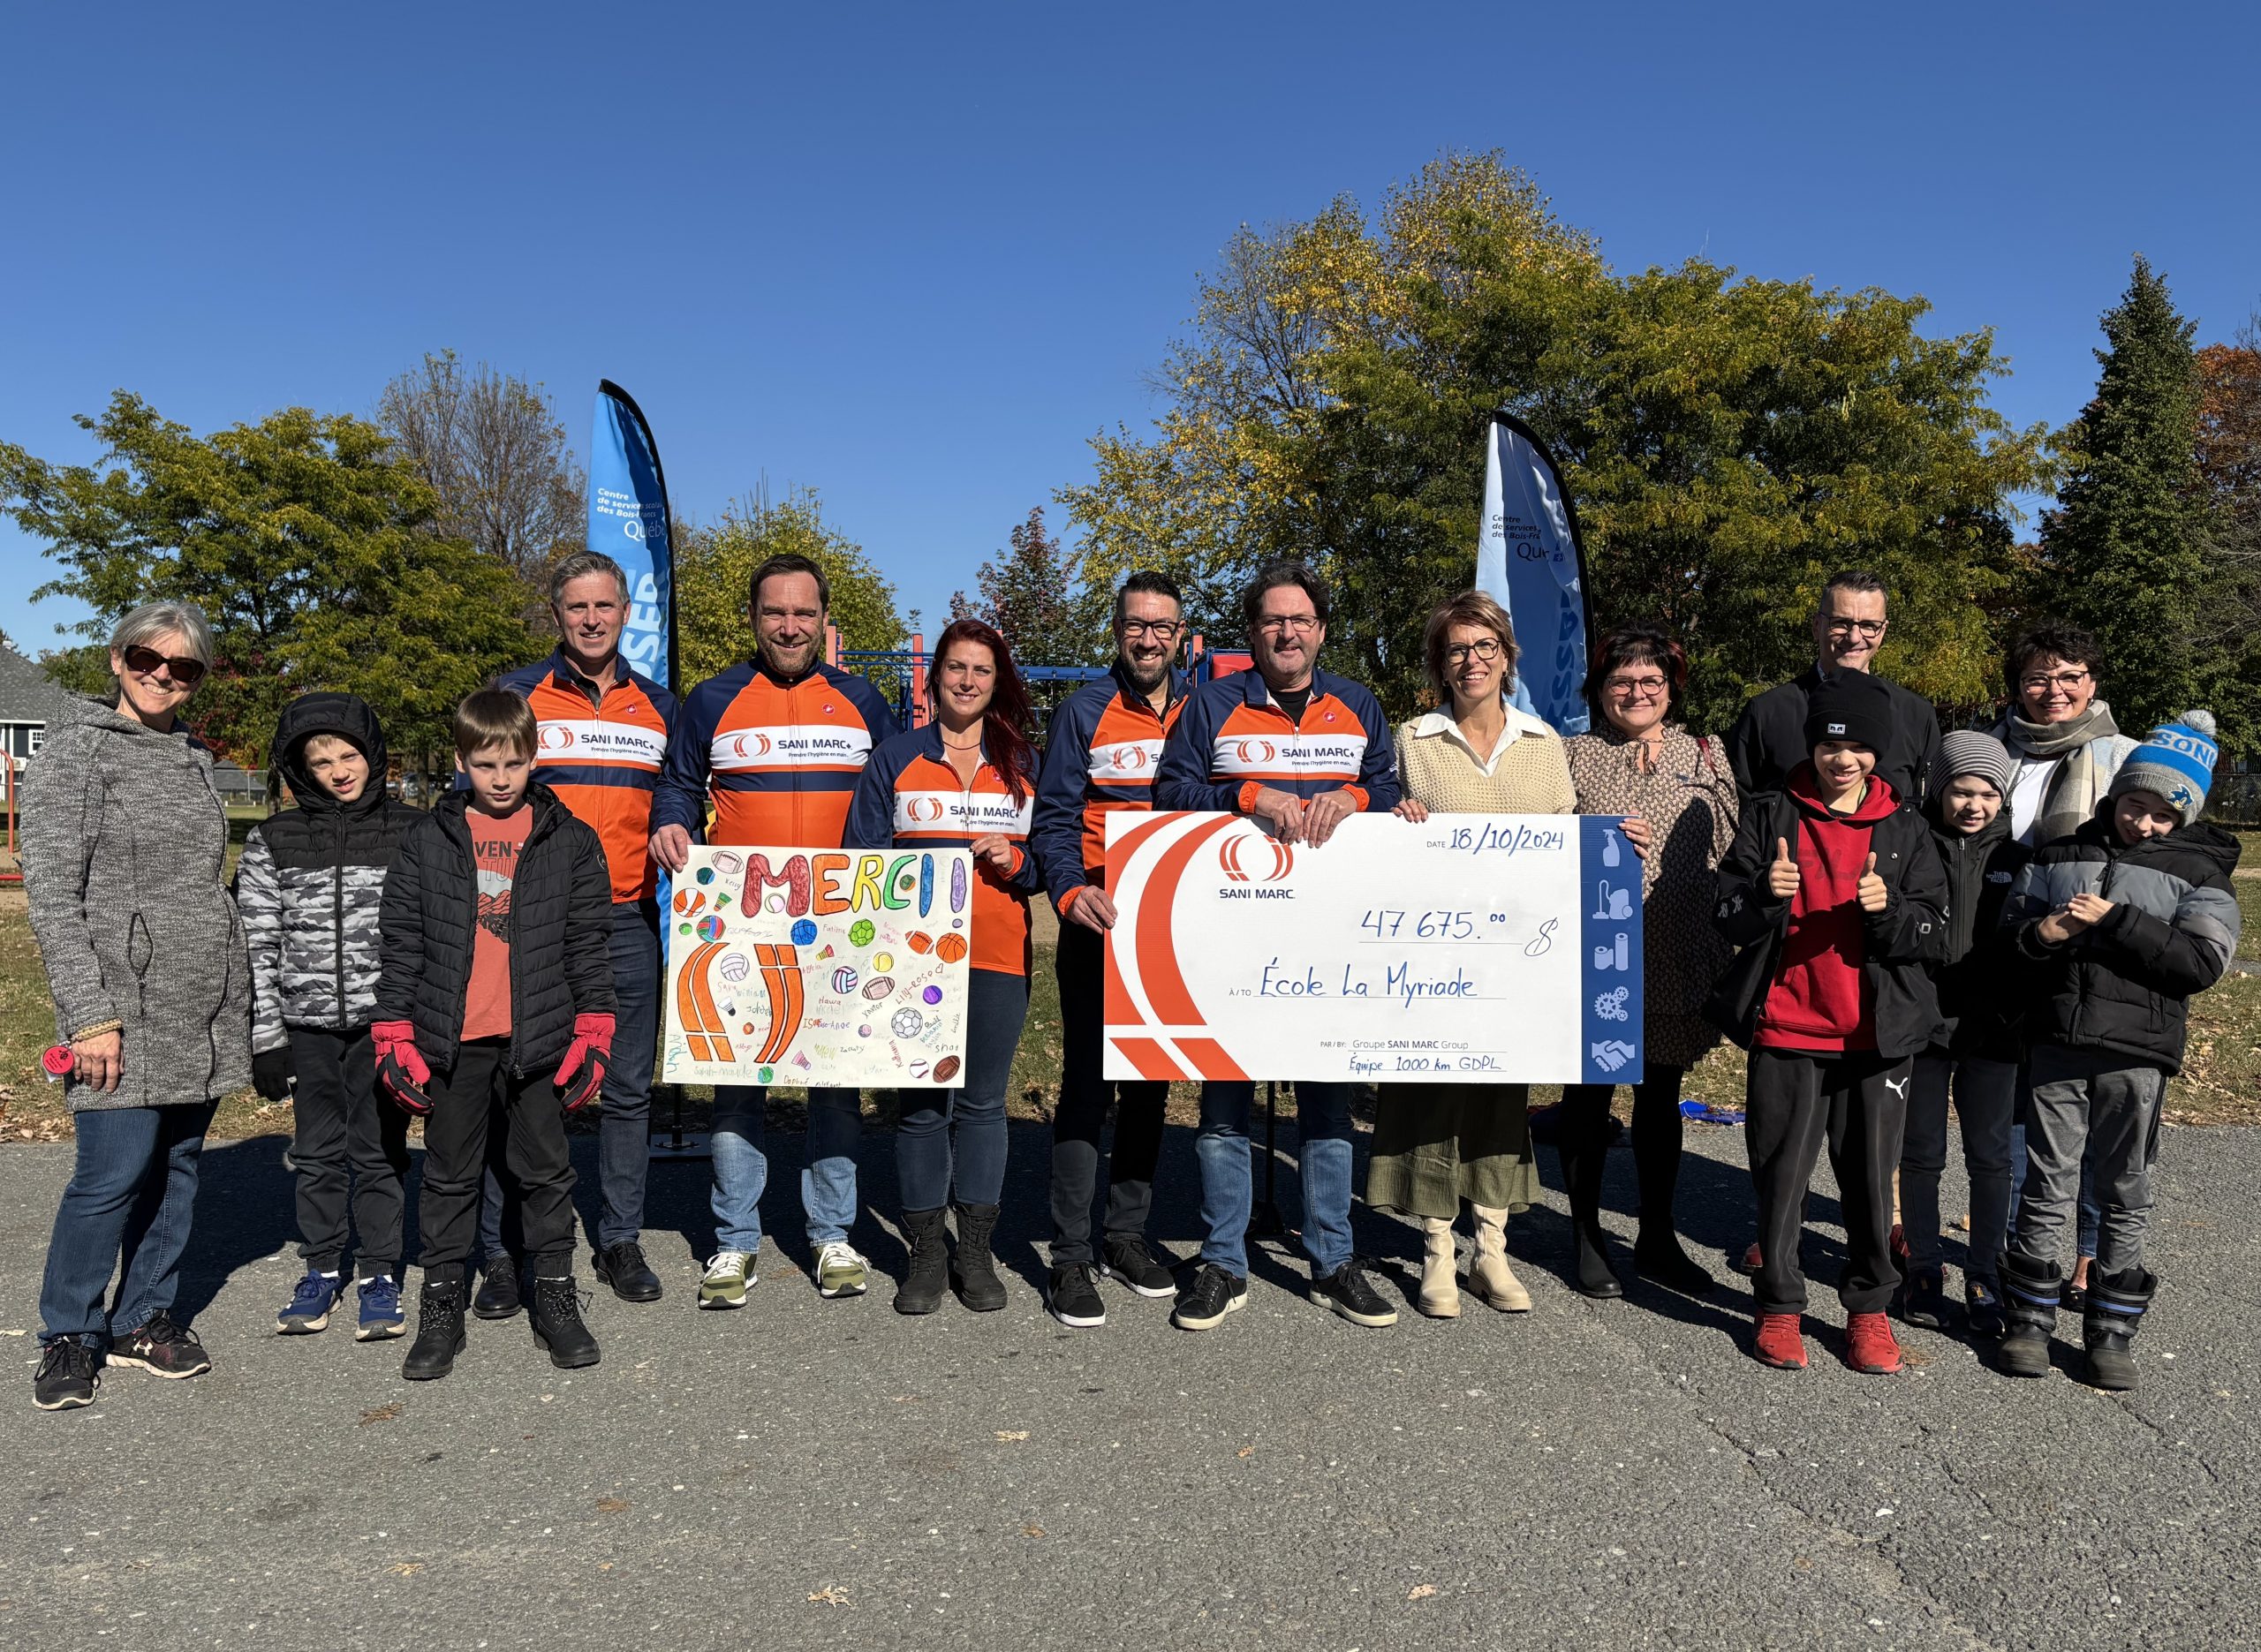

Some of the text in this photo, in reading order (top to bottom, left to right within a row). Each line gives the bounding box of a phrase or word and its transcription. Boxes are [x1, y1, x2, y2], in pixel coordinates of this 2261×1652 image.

[597, 487, 630, 502] Centre
[597, 506, 614, 515] des
[612, 500, 643, 509] services
[1492, 514, 1521, 523] Centre
[581, 734, 649, 750] SANI MARC
[778, 738, 847, 750] SANI MARC
[1282, 747, 1350, 758] SANI MARC
[949, 805, 1016, 818] SANI MARC
[1449, 822, 1563, 857] 18/10/2024
[741, 853, 934, 917] MERCI
[1219, 888, 1294, 899] SANI MARC
[1361, 910, 1406, 938] 47
[1524, 917, 1558, 956] $
[1259, 957, 1478, 1008] École La Myriade
[1352, 1040, 1385, 1050] Groupe
[1388, 1040, 1410, 1049] SANI
[1412, 1040, 1439, 1049] MARC
[1441, 1041, 1469, 1050] Group
[1396, 1056, 1429, 1071] 1000
[1434, 1057, 1451, 1070] km
[1459, 1055, 1501, 1070] GDPL
